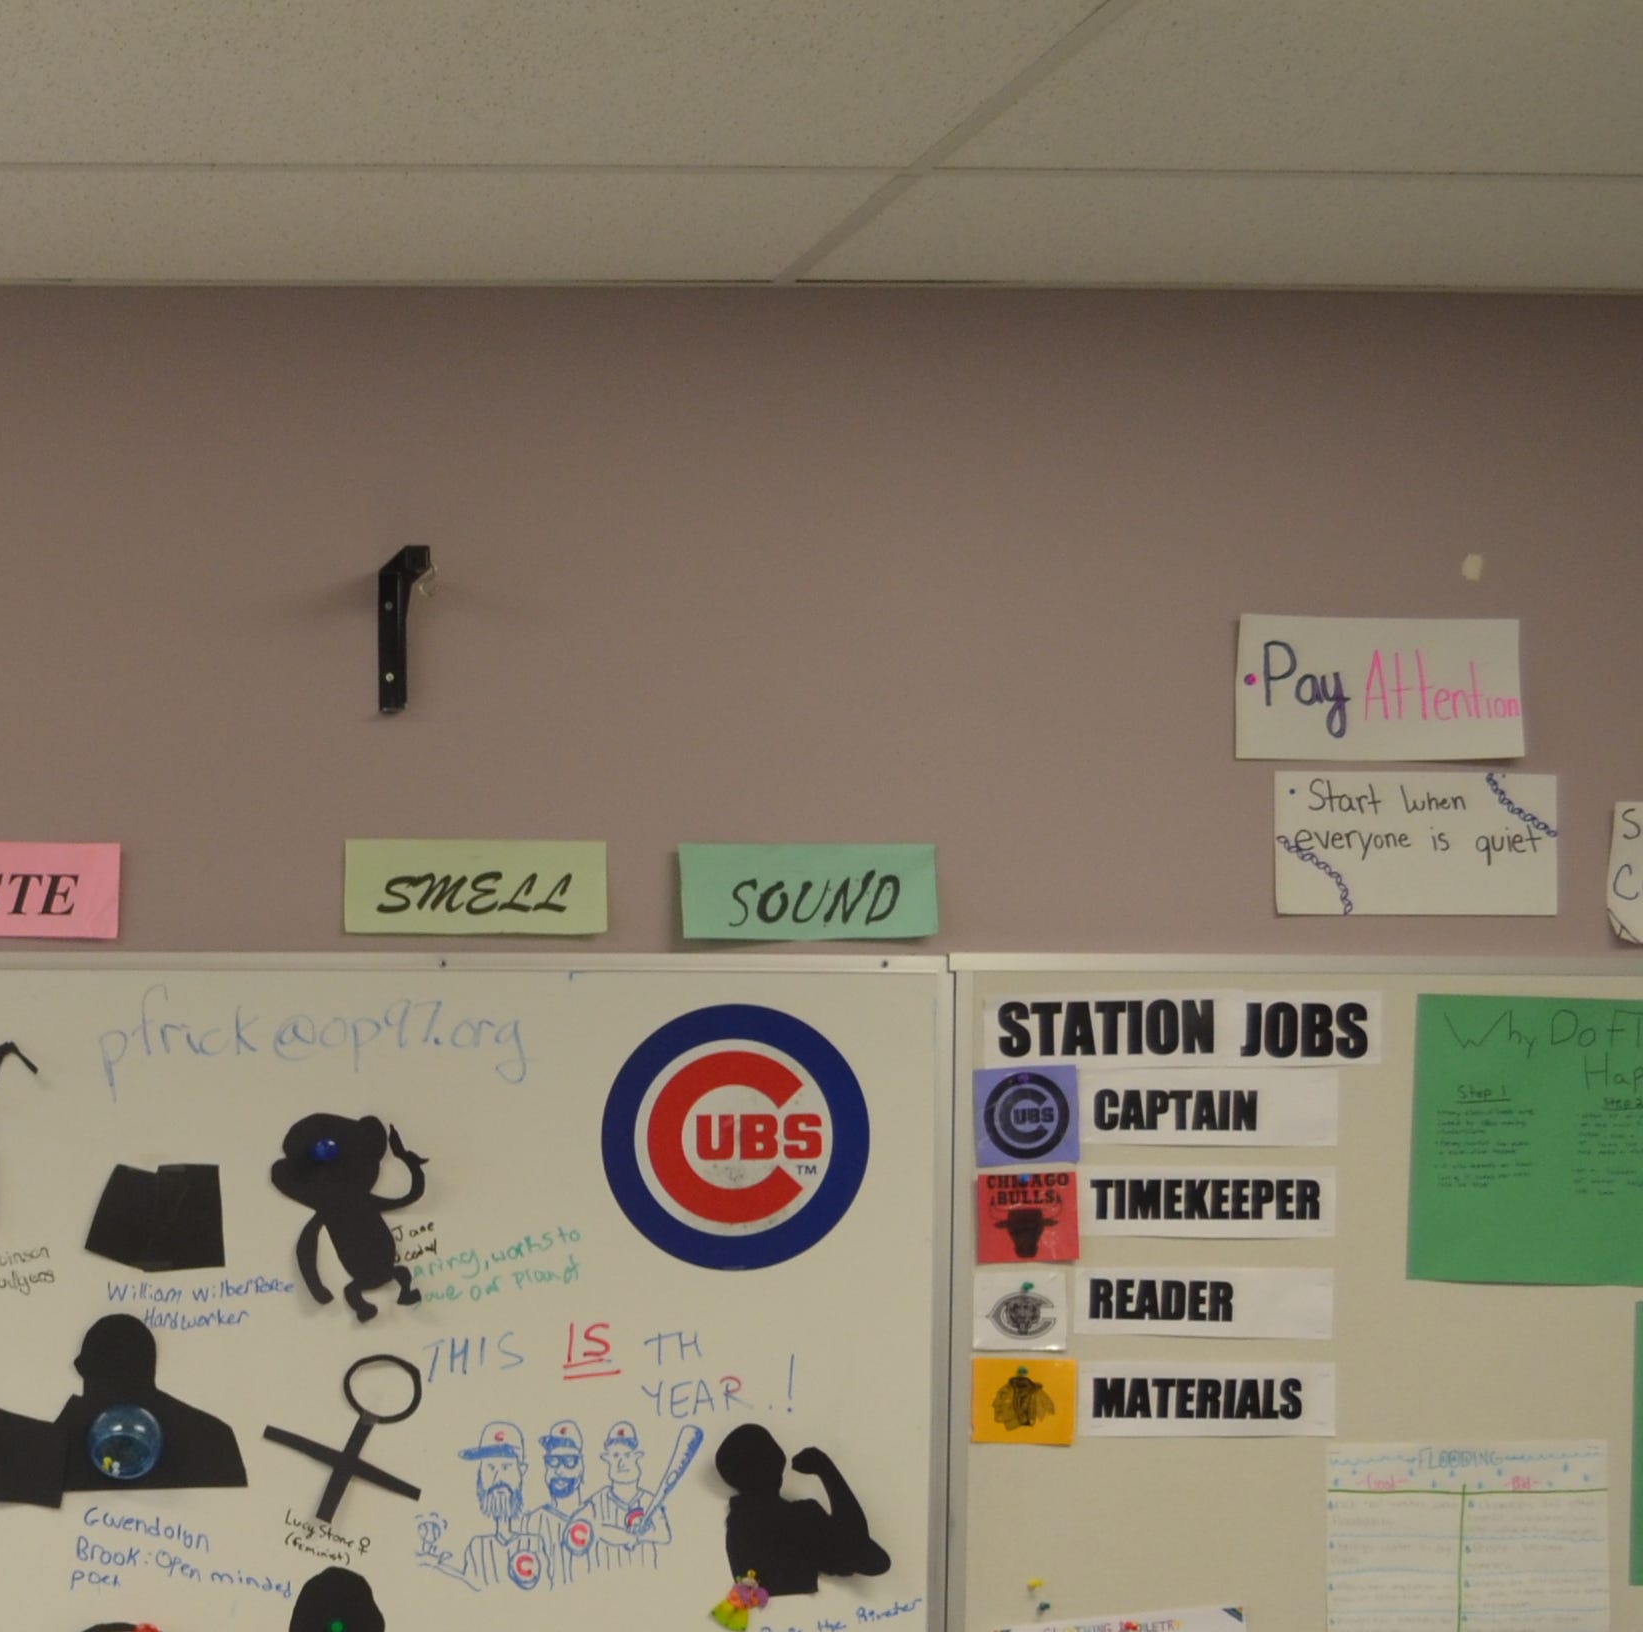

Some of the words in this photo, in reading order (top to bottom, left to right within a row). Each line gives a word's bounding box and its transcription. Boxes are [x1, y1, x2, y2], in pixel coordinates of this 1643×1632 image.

[1262, 640, 1351, 738] Pay
[1364, 650, 1521, 721] Attention
[1308, 778, 1382, 815] Start
[1294, 827, 1412, 860] everyone
[1430, 827, 1452, 852] is
[1475, 829, 1544, 866] quiet
[377, 874, 576, 917] SMELL
[727, 870, 902, 927] SOUND
[996, 999, 1216, 1059] STATION
[1239, 1001, 1370, 1059] JOBS
[1444, 1009, 1537, 1058] Why
[1551, 1009, 1596, 1047] Do
[1093, 1089, 1260, 1132] CAPTAIN
[1089, 1178, 1322, 1221] TIMEKEEPER
[1088, 1277, 1235, 1324] READER
[423, 1330, 526, 1384] THIS
[566, 1323, 612, 1364] IS
[1091, 1377, 1304, 1422] MATERIALS
